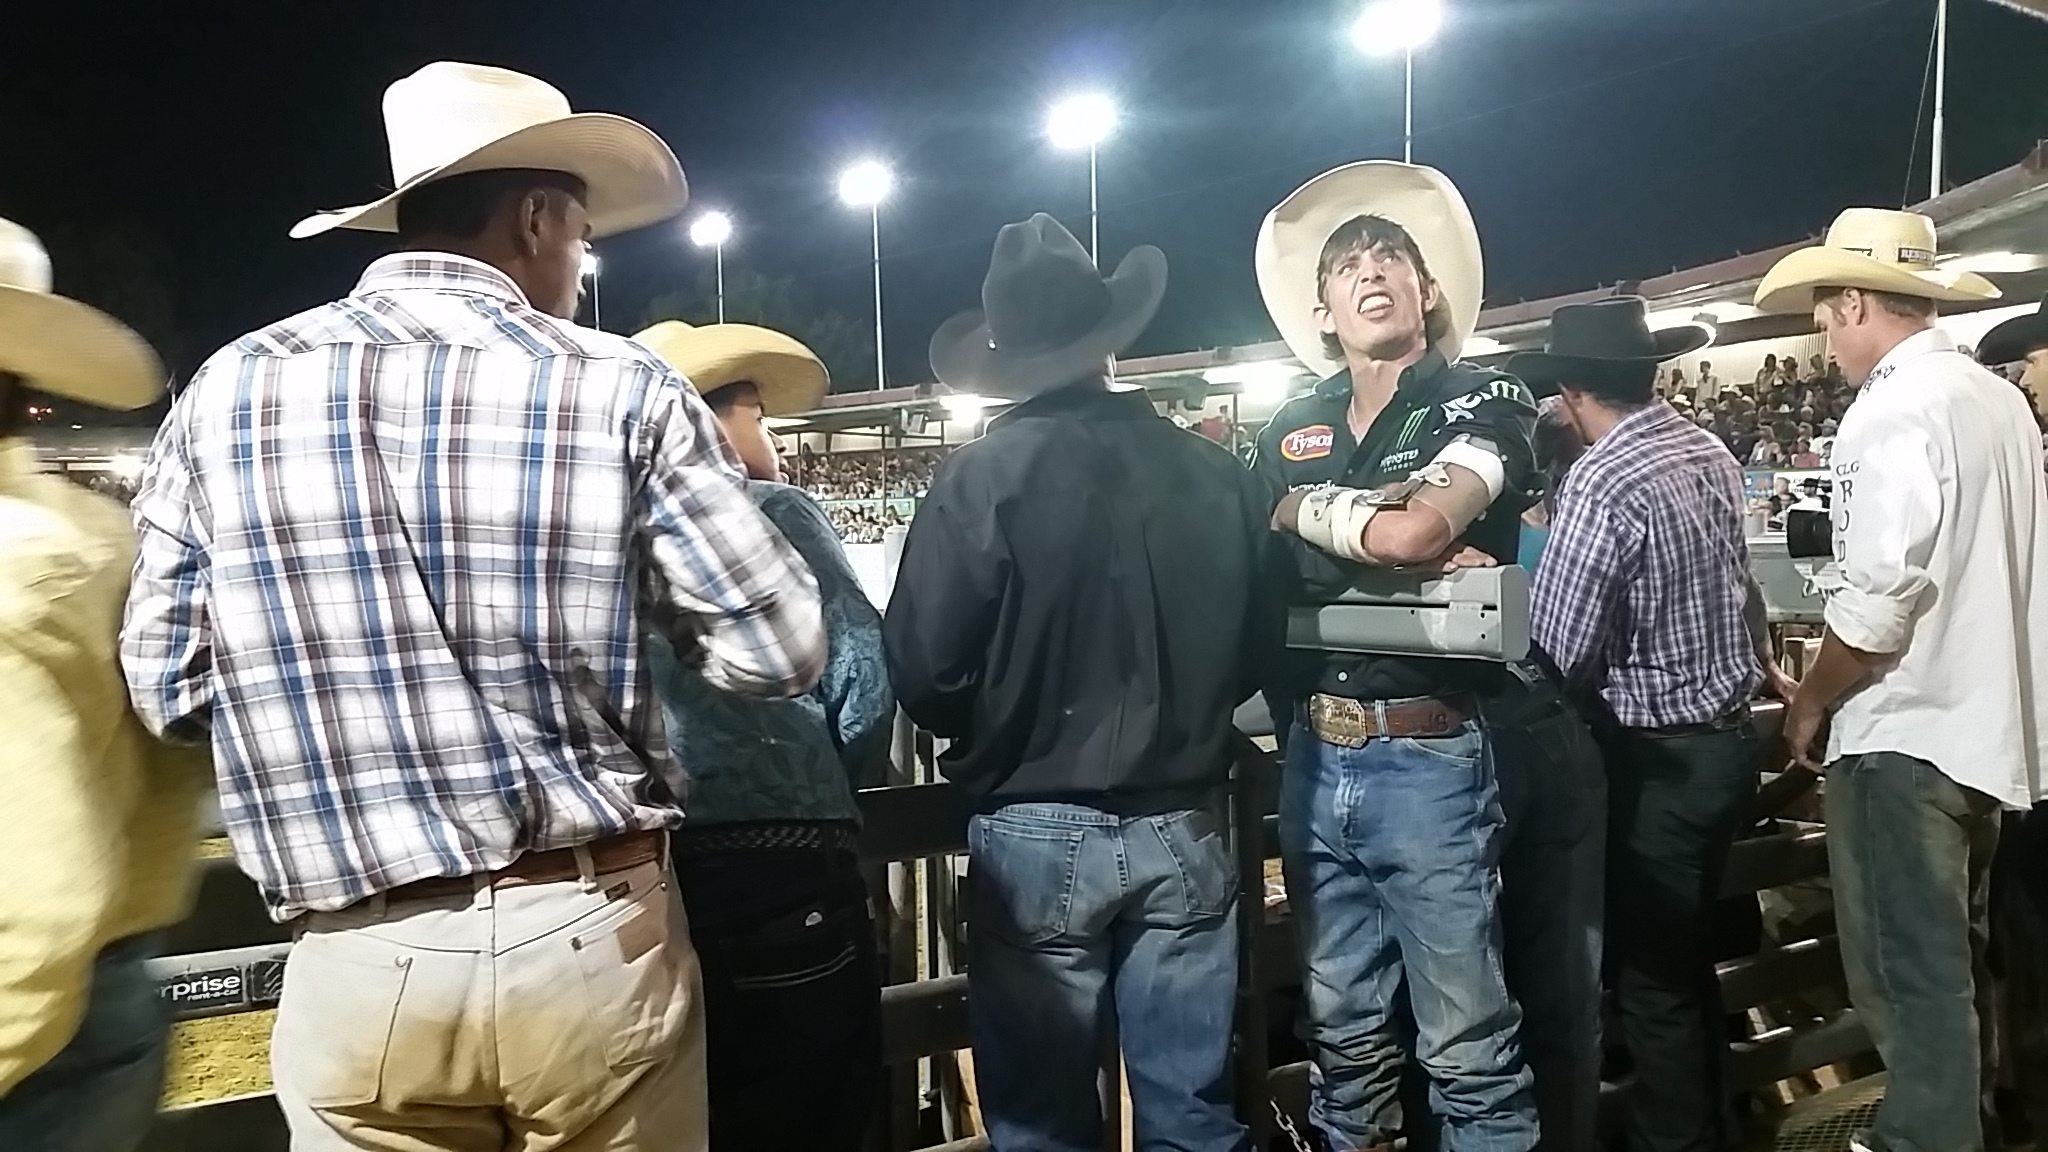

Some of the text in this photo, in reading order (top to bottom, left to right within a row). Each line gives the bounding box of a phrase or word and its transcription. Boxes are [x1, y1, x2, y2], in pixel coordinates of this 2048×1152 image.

[1836, 461, 1860, 476] CLG
[159, 975, 241, 1001] rprise
[187, 988, 240, 1000] rent-a-car
